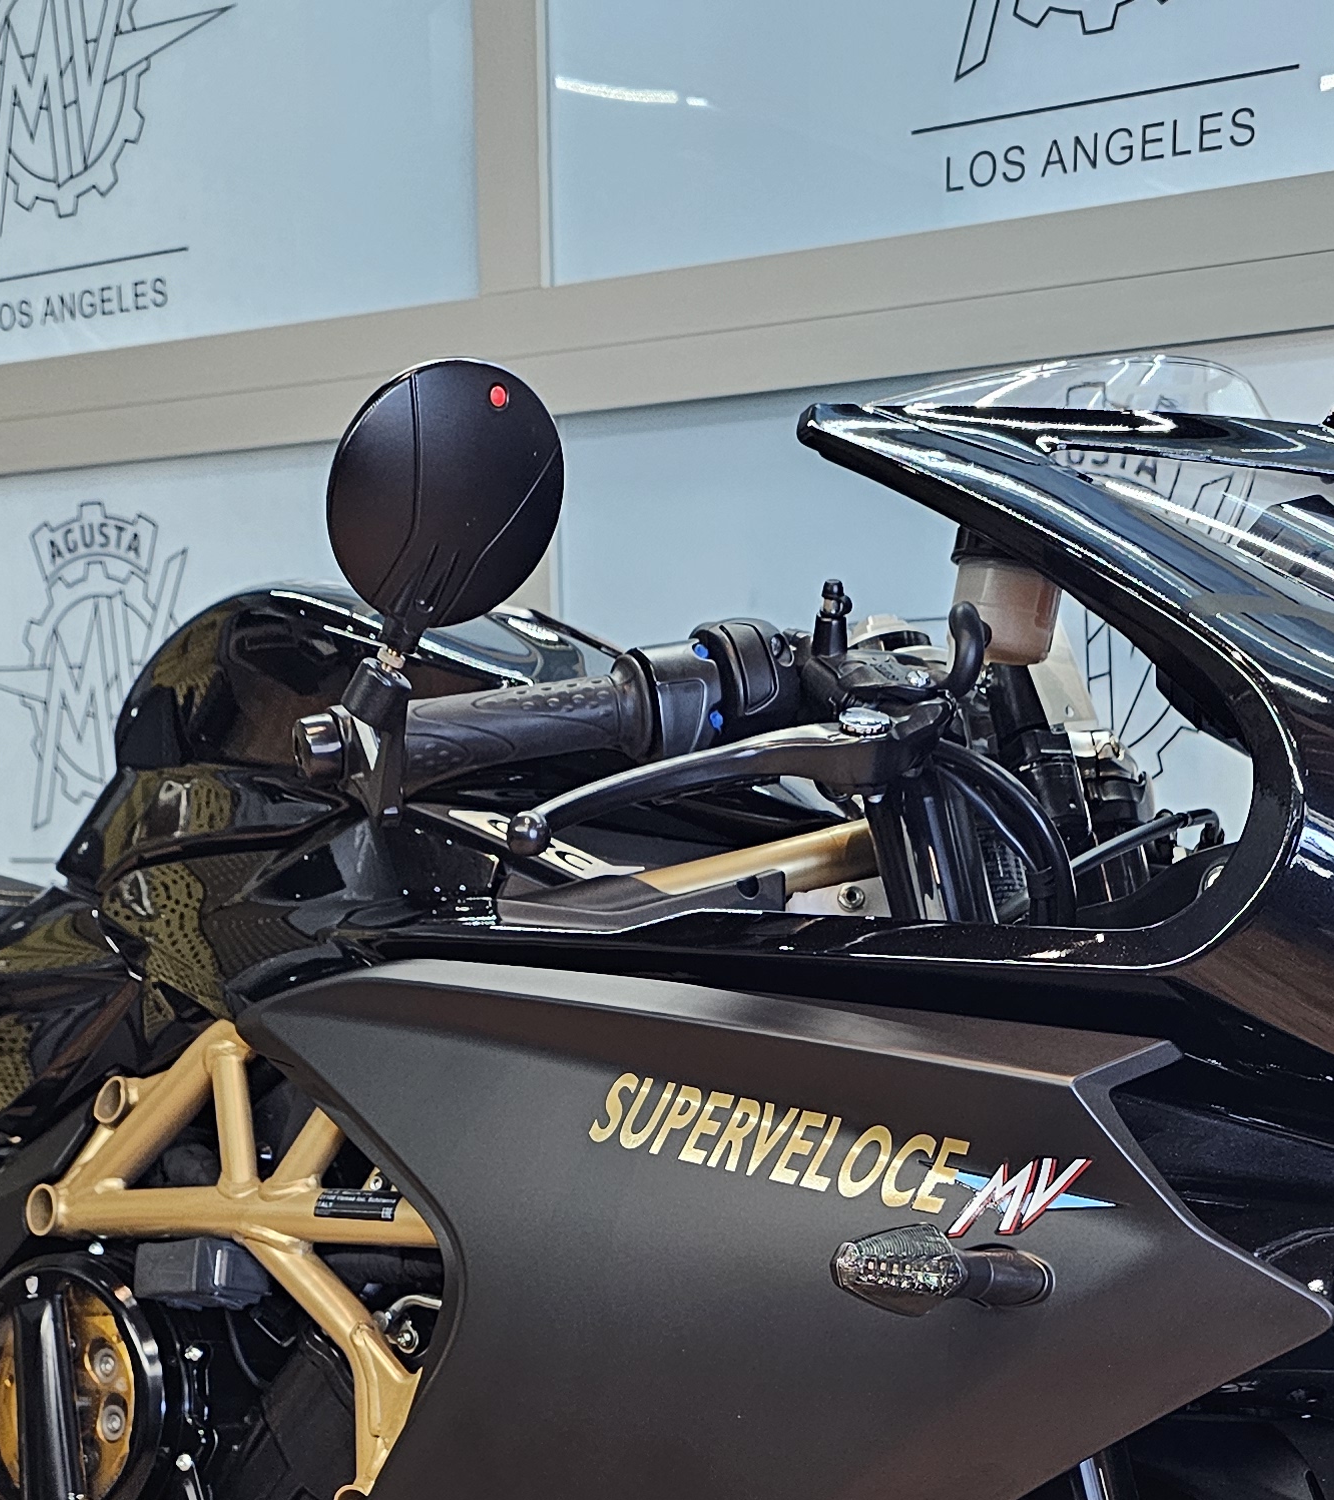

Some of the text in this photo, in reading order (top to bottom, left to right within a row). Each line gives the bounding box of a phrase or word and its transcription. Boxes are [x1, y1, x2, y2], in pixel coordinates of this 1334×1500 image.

[945, 106, 1256, 193] LOS ANGELES
[40, 276, 169, 326] ANGELES
[48, 521, 142, 567] AGUSTA
[587, 1072, 1094, 1238] SUPERVELOCE MV
